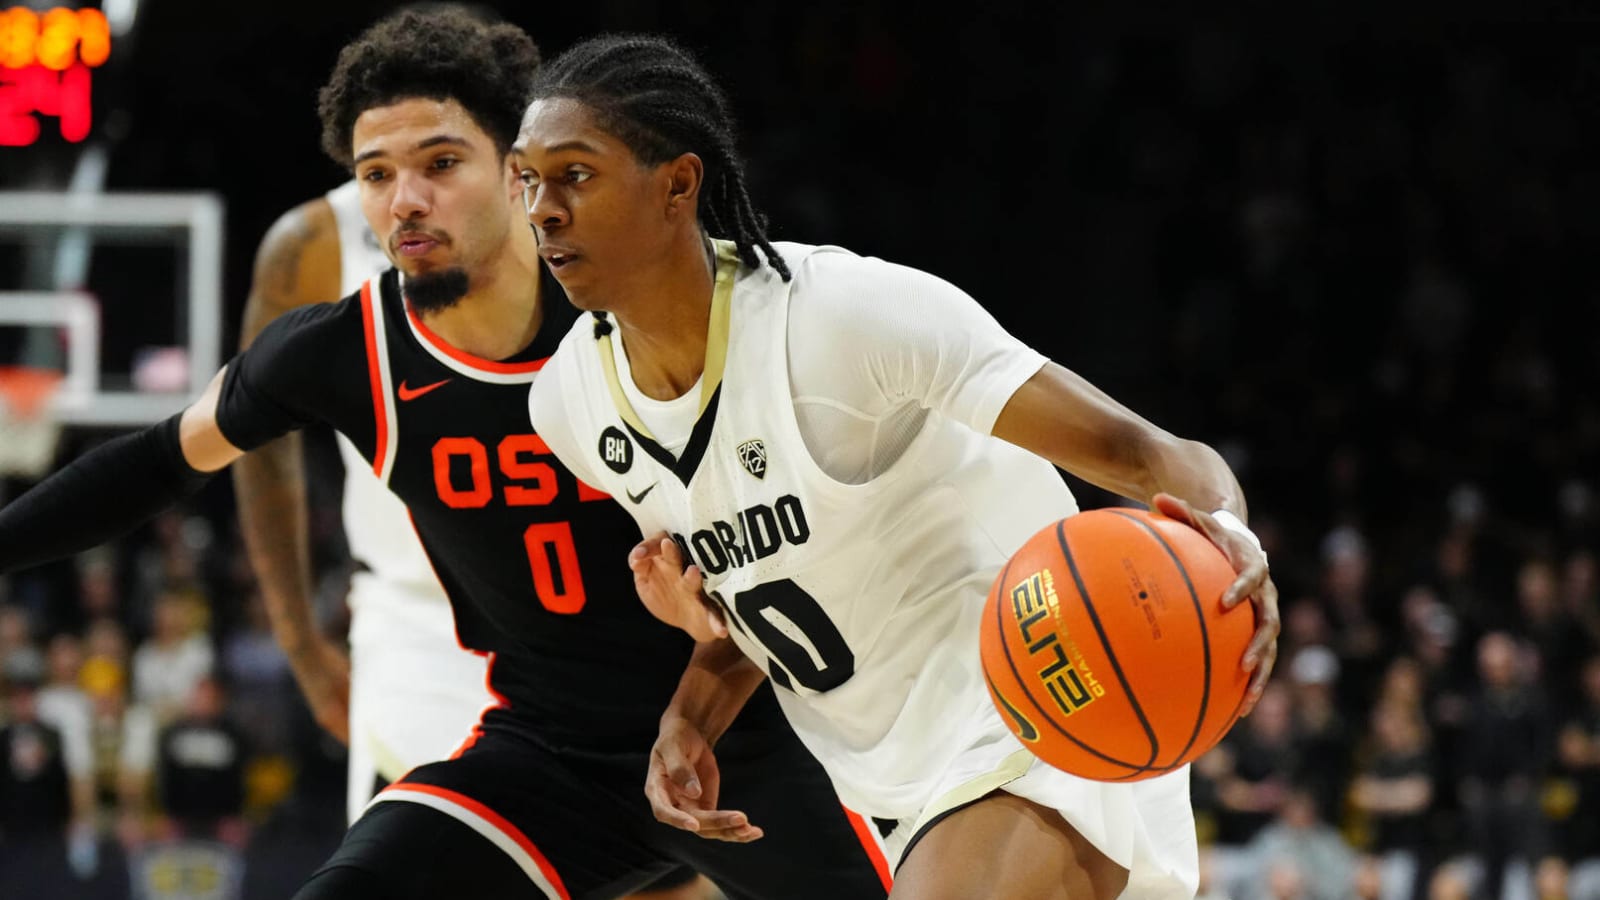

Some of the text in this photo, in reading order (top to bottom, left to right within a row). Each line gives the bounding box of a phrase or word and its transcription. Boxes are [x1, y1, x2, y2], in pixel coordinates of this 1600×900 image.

[431, 434, 613, 509] OS
[605, 436, 627, 463] BH
[738, 440, 767, 467] PAC
[748, 456, 765, 474] 12
[523, 519, 588, 615] 0
[672, 493, 811, 579] ORADO
[1010, 572, 1096, 717] ELITE
[1042, 568, 1105, 697] CHAMONSHIP
